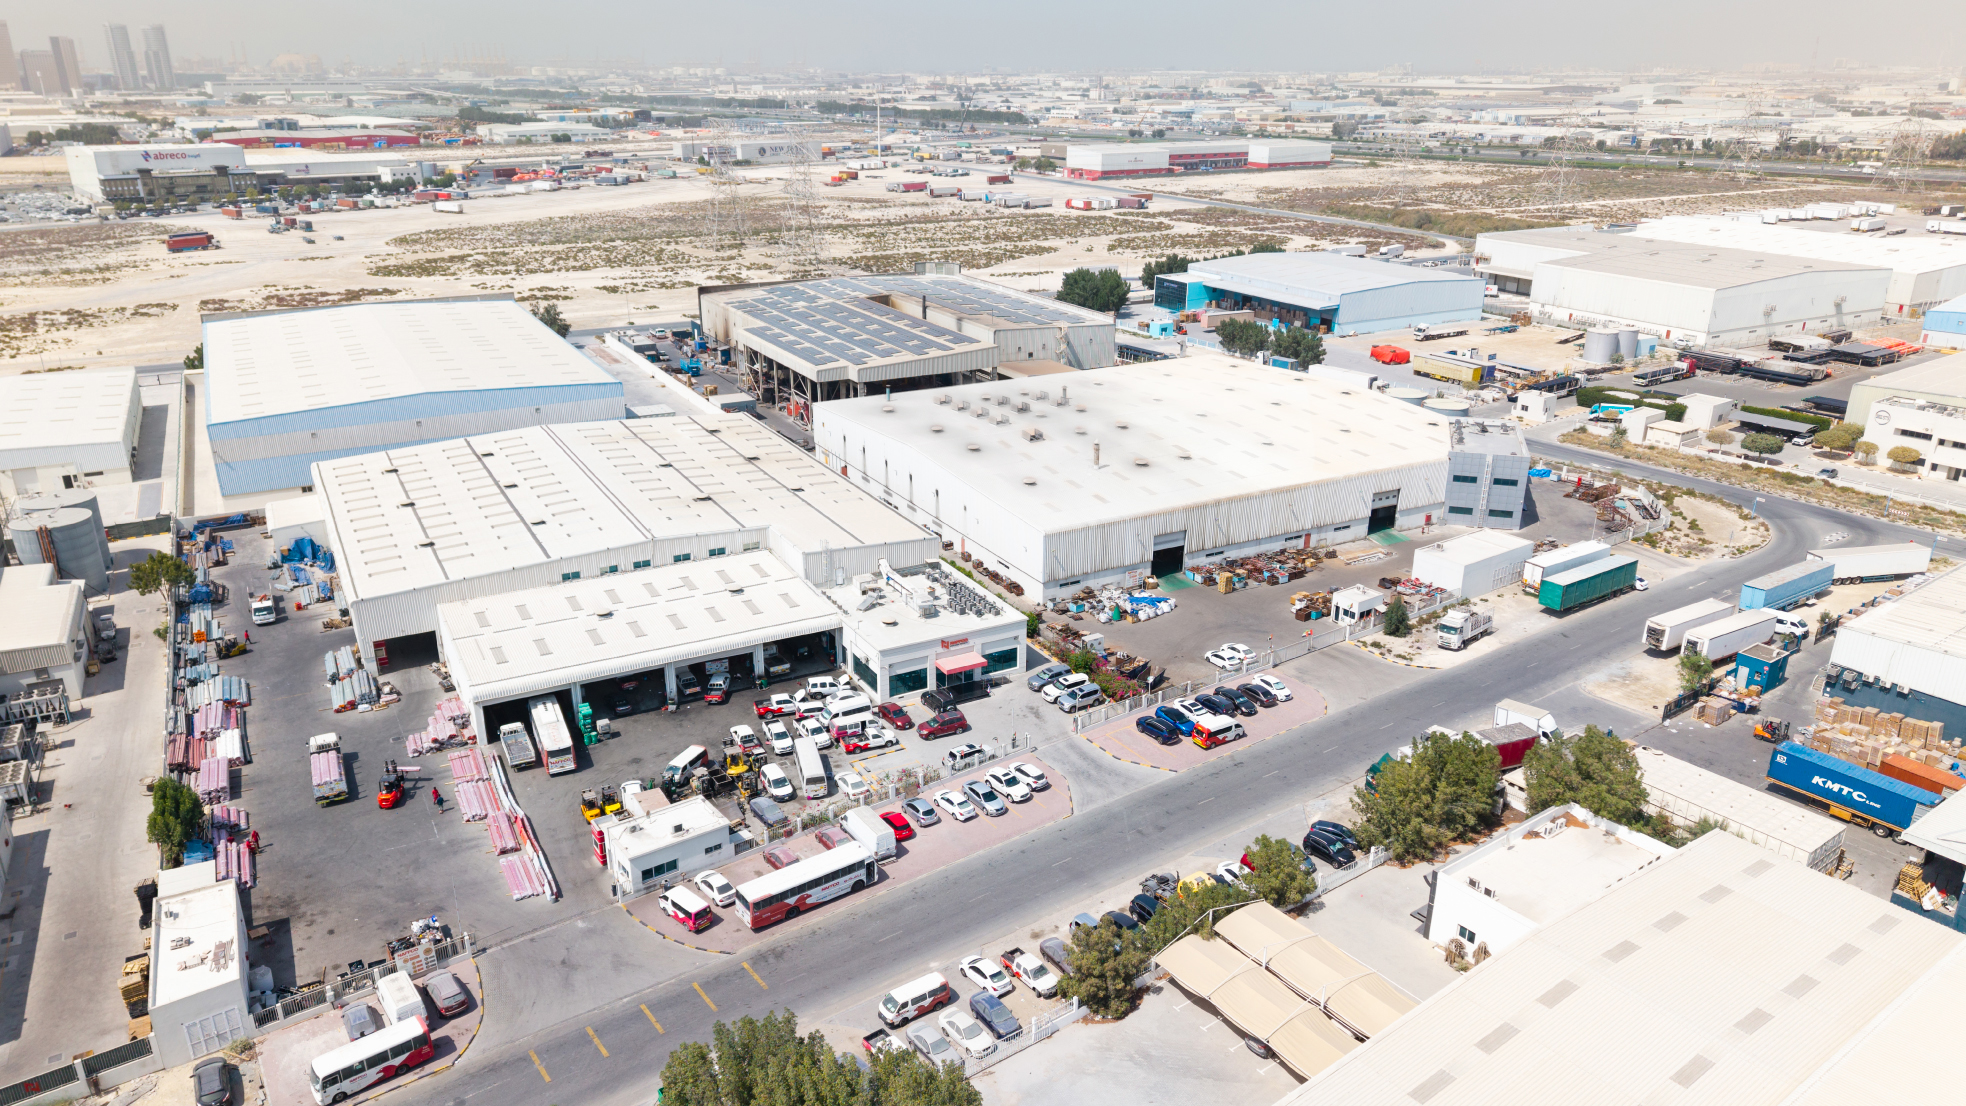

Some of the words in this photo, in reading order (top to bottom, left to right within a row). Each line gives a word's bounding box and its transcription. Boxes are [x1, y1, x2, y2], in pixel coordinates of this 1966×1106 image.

[153, 152, 186, 160] abreco
[1812, 775, 1866, 802] KMTC
[1866, 800, 1881, 808] LINE
